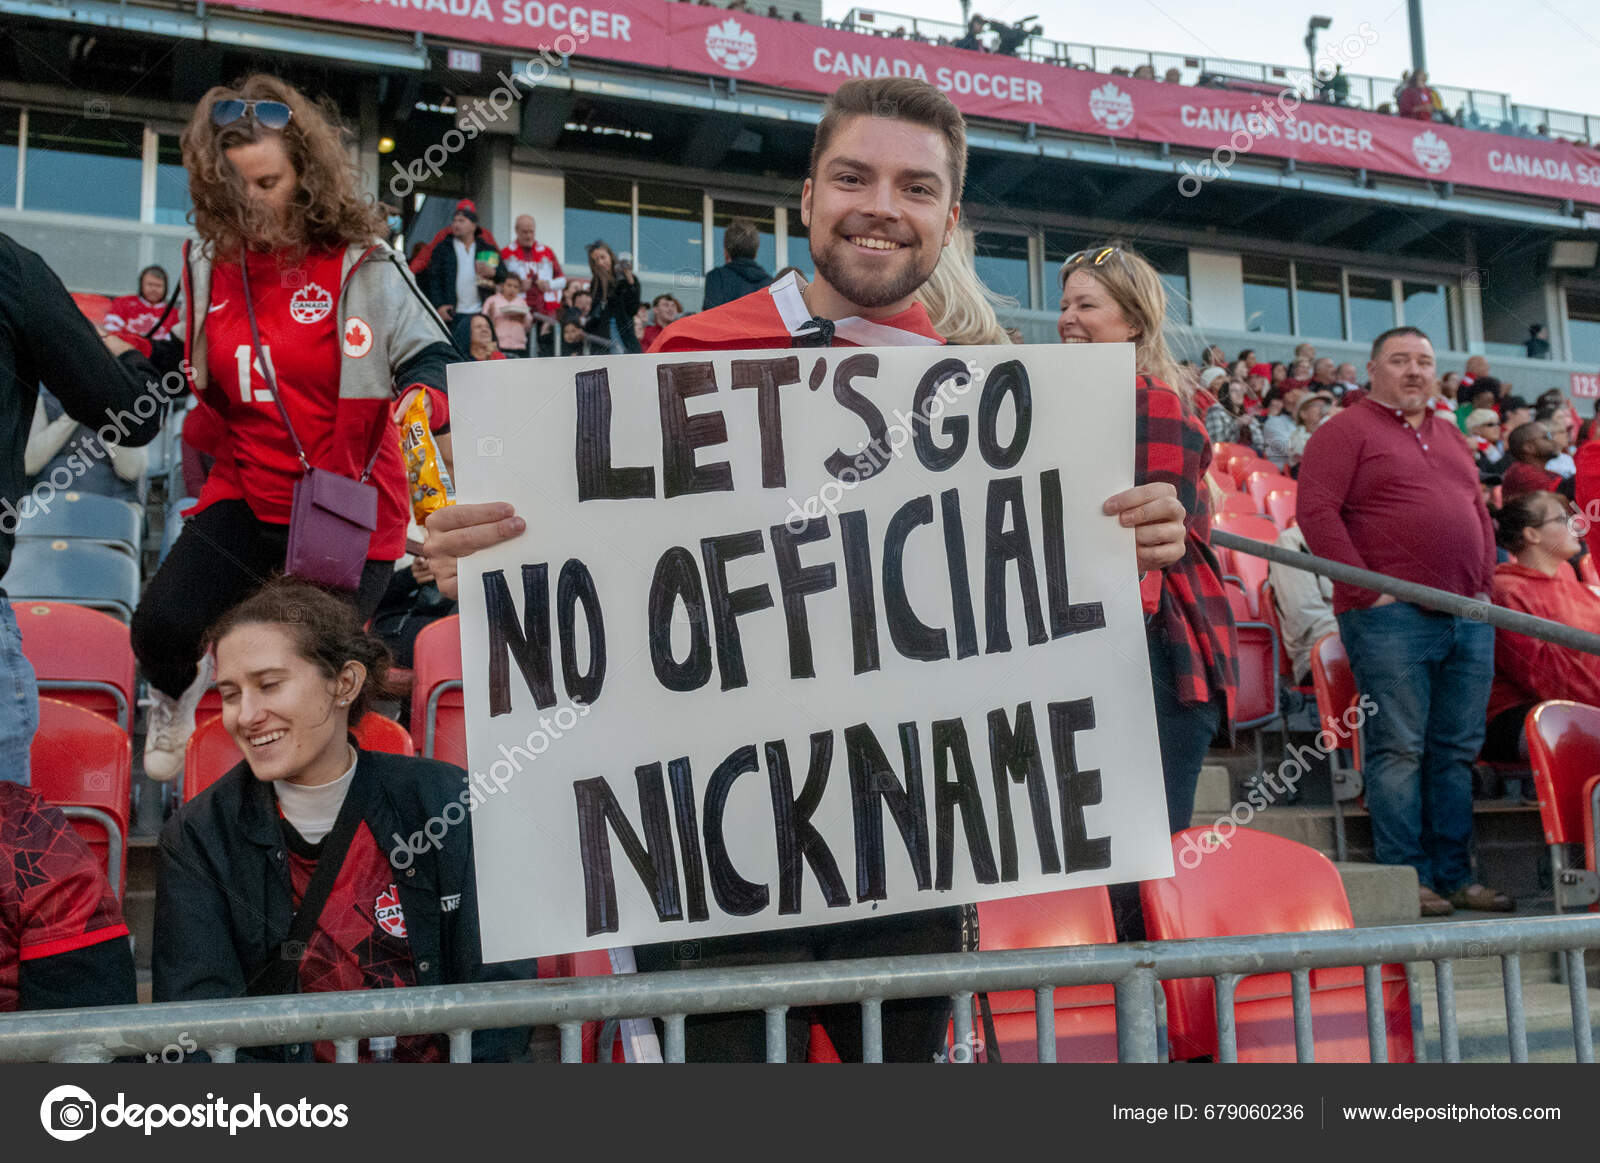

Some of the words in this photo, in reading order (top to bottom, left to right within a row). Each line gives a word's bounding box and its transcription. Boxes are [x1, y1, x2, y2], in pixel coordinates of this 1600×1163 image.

[502, 0, 632, 41] SOCCER
[813, 48, 928, 81] CANADA
[937, 67, 1044, 105] SOCCER
[1180, 104, 1280, 138] CANADA
[1284, 121, 1375, 152] SOCCER
[1488, 150, 1574, 183] CANADA
[1573, 375, 1598, 397] 125
[575, 353, 894, 502] LET'S
[911, 357, 1033, 473] GO
[482, 558, 607, 717] NO
[648, 468, 1106, 692] OFFICIAL
[573, 697, 1111, 937] NICKNAME
